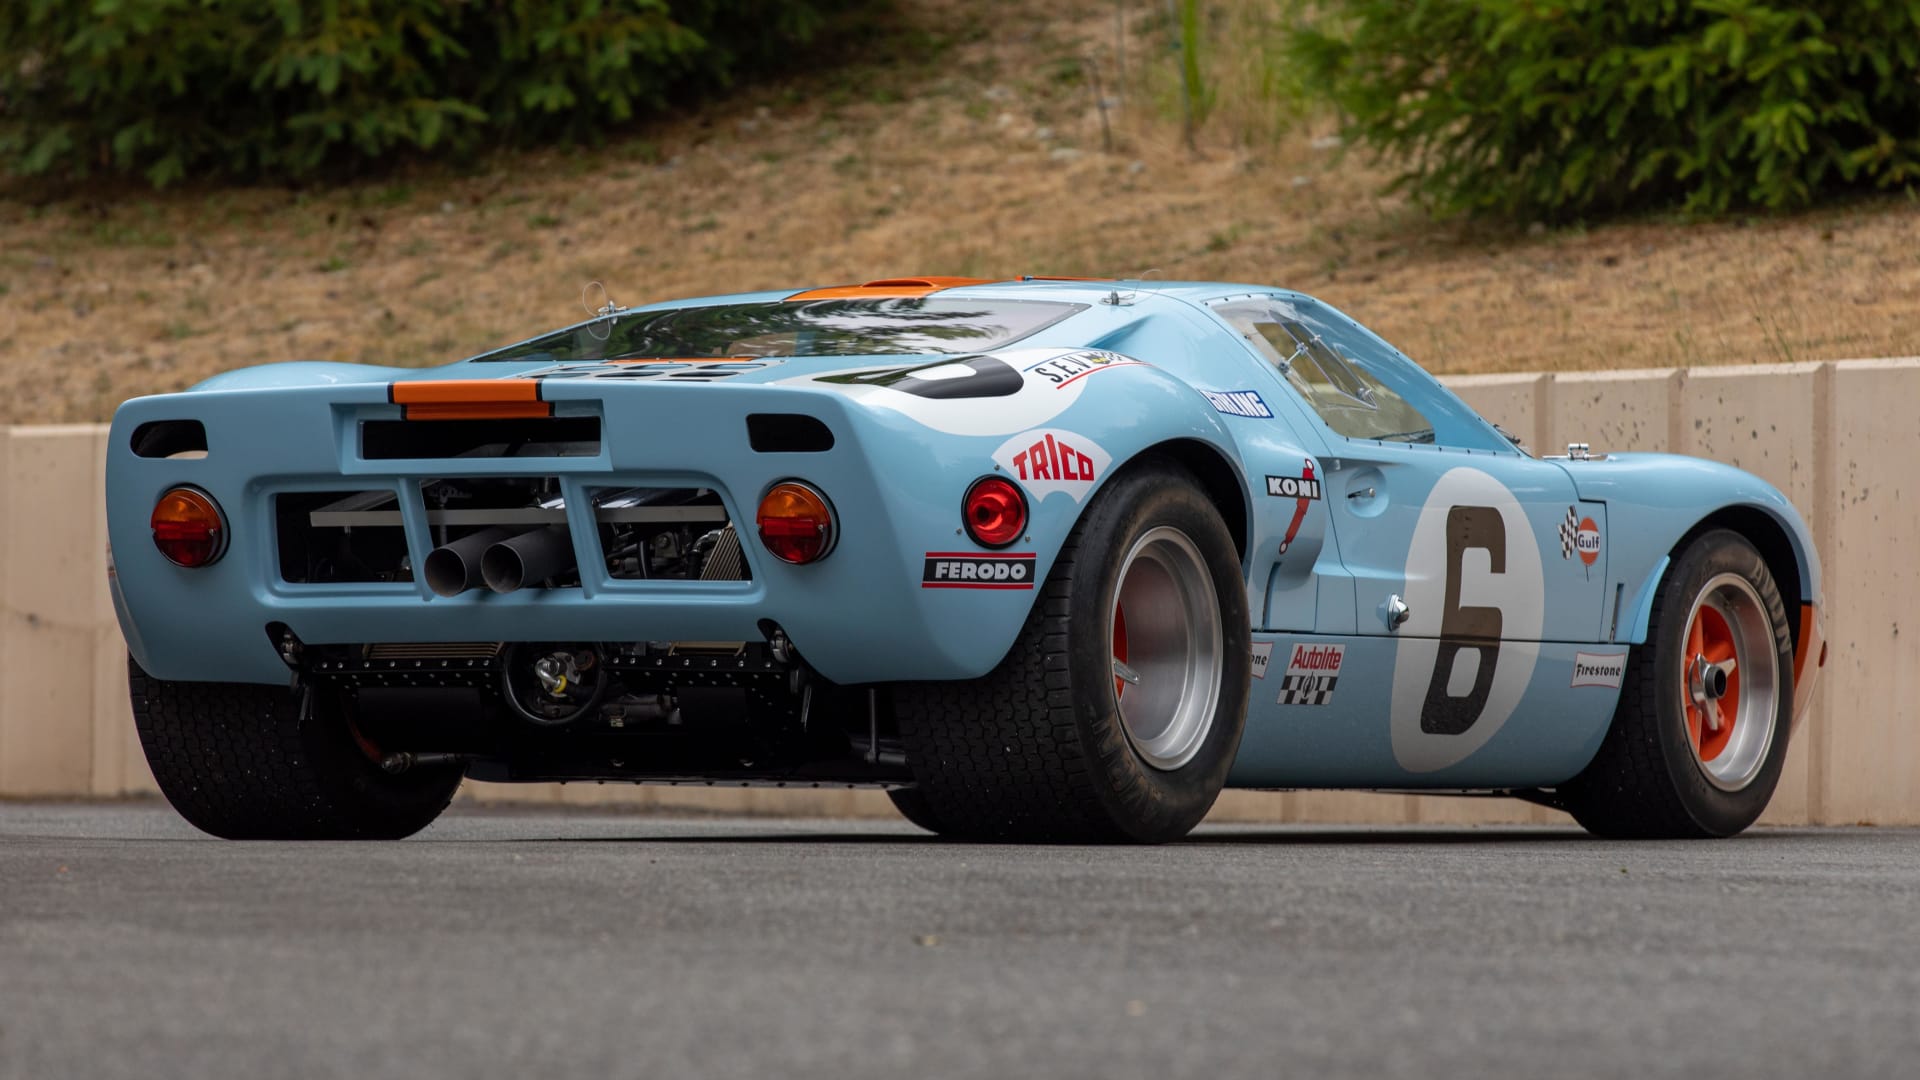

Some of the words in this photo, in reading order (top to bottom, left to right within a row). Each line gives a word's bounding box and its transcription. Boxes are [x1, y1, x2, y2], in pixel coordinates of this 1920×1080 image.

[1013, 433, 1094, 481] TRICO
[1267, 477, 1318, 498] KONI
[1577, 534, 1600, 549] Gulf
[935, 561, 1027, 580] FERODO
[1750, 556, 1792, 654] AVON
[1420, 505, 1506, 735] 6
[1290, 645, 1342, 671] Autolite
[1576, 663, 1621, 678] Firestone
